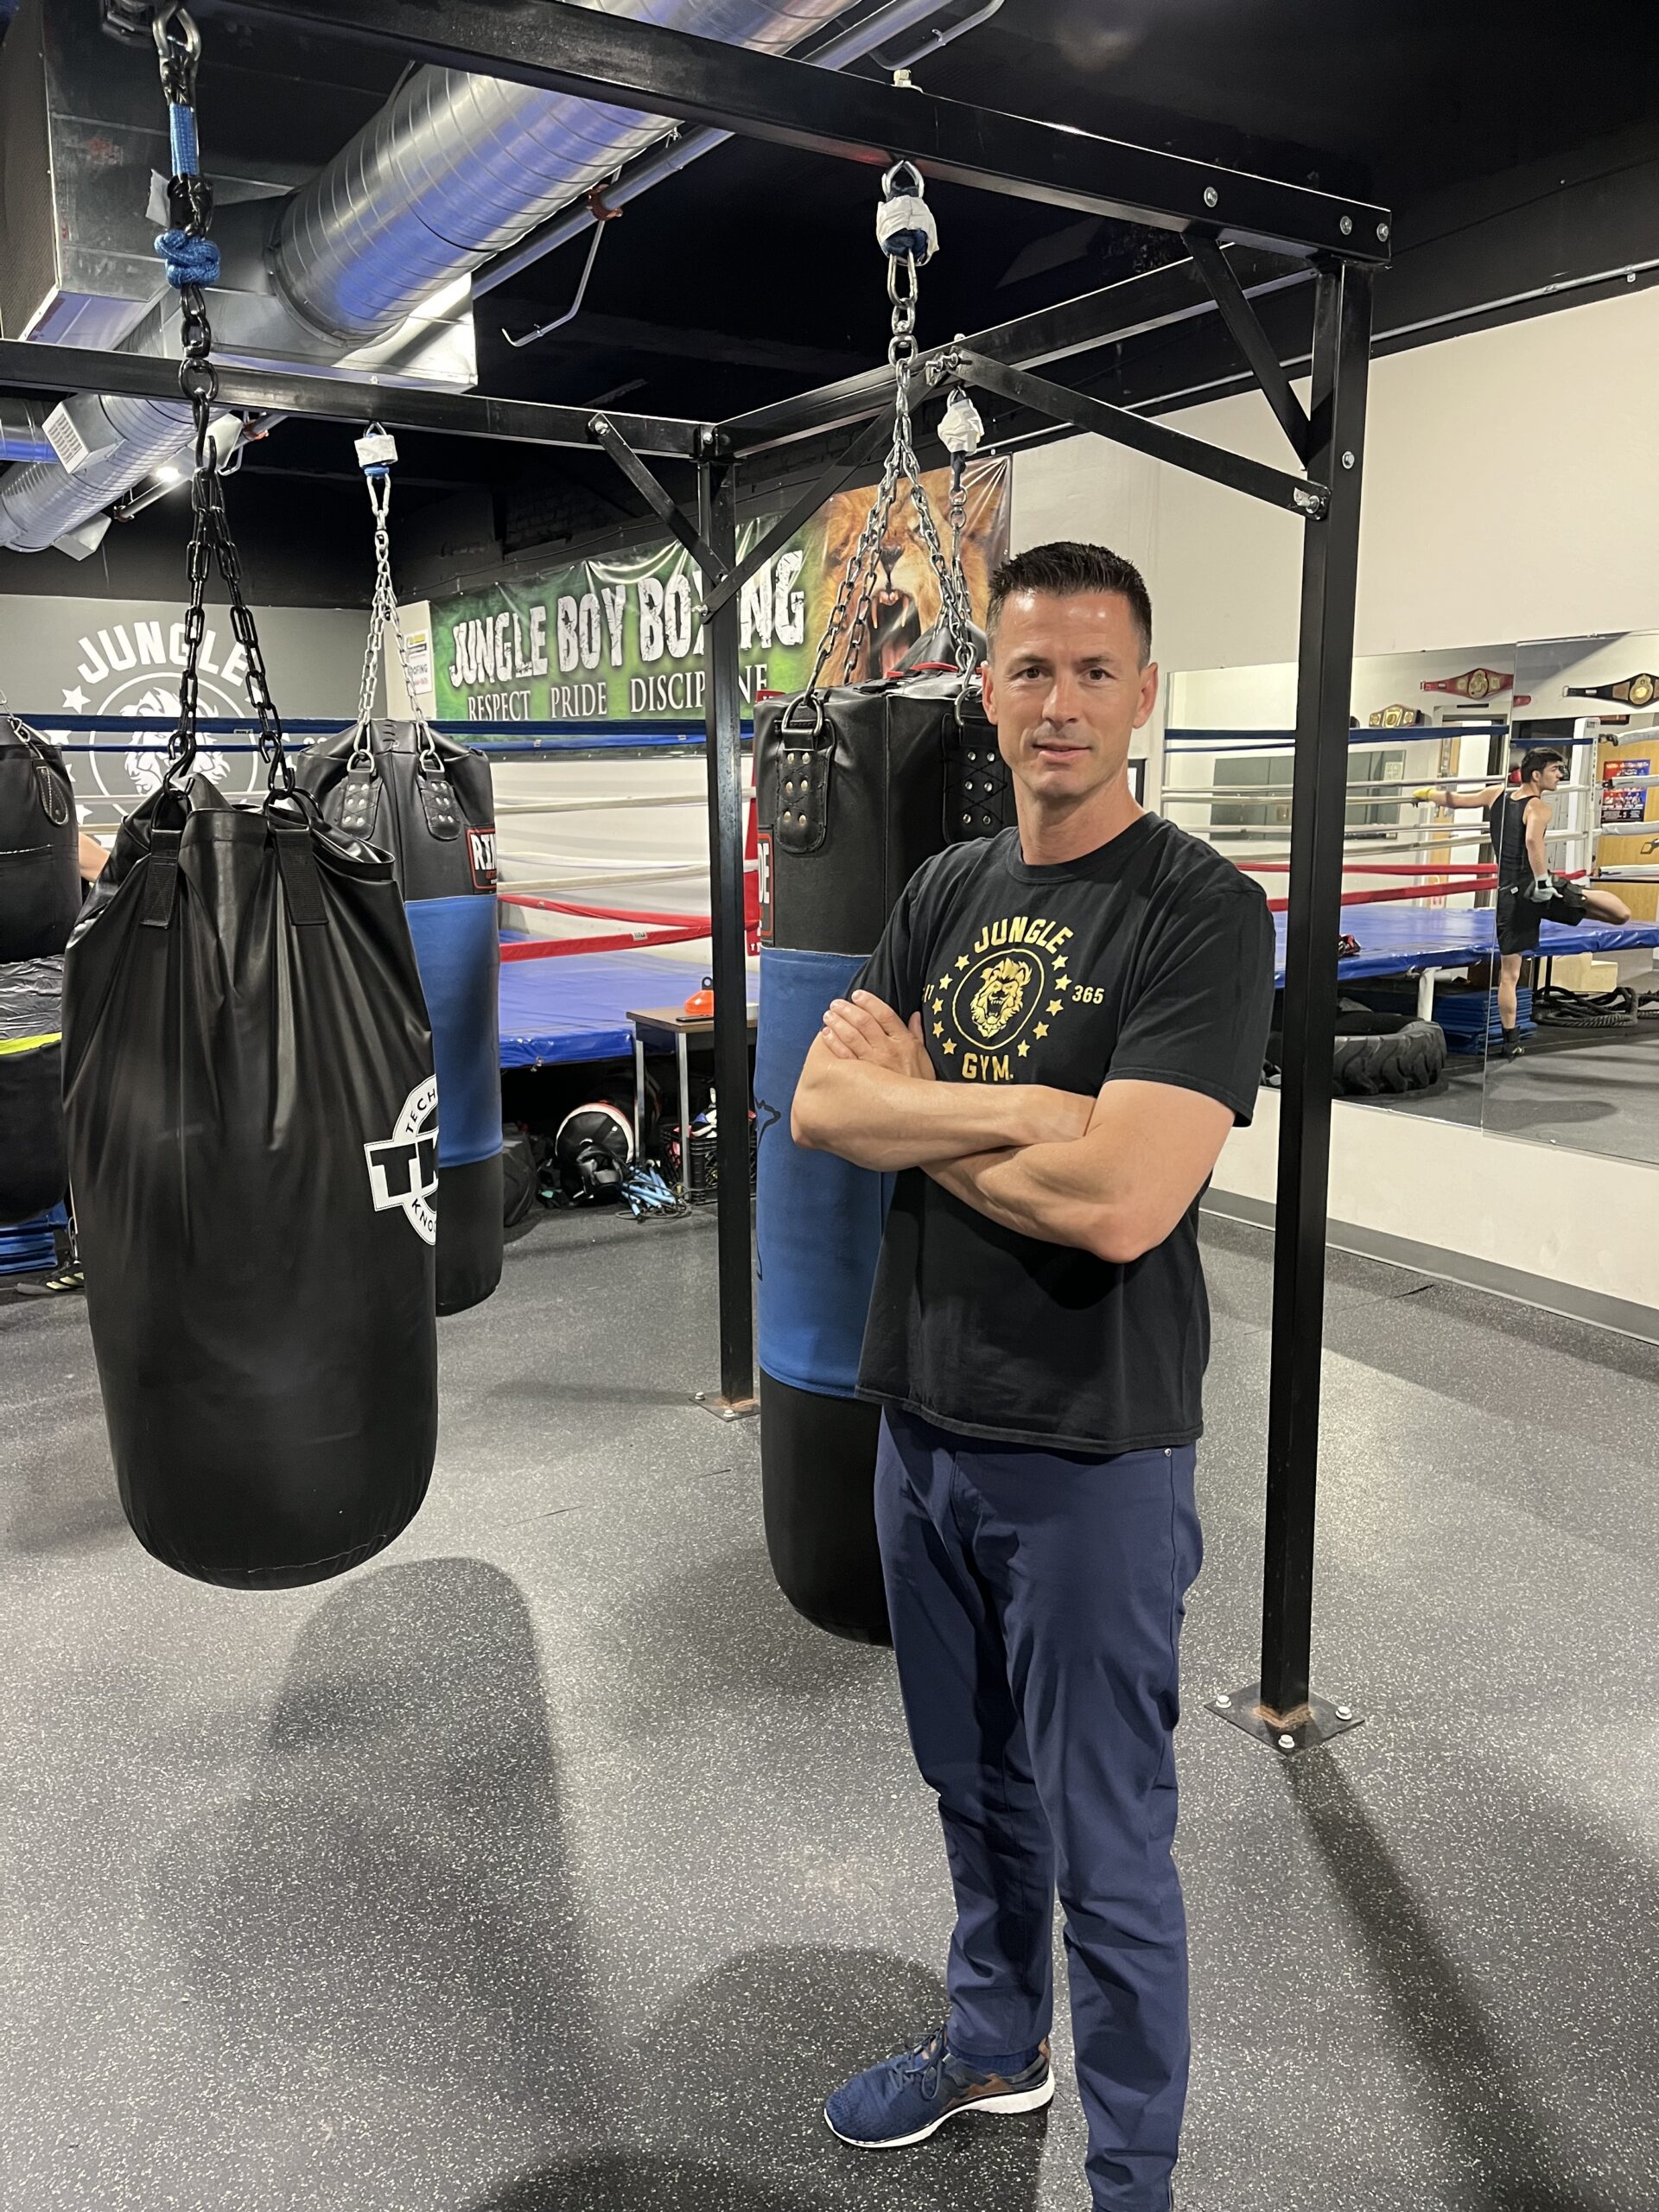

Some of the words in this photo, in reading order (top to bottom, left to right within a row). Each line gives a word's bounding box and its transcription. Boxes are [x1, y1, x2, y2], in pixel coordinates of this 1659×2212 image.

[76, 620, 256, 685] JUNGLE
[448, 605, 549, 688] JUNGLE
[556, 582, 626, 672] BOY
[467, 690, 531, 721] RESPECT
[550, 681, 607, 719] PRIDE
[630, 663, 768, 713] DISCIPNE
[973, 916, 1073, 955] JUNGLE
[1071, 984, 1105, 1005] 365
[411, 1198, 436, 1233] KNO
